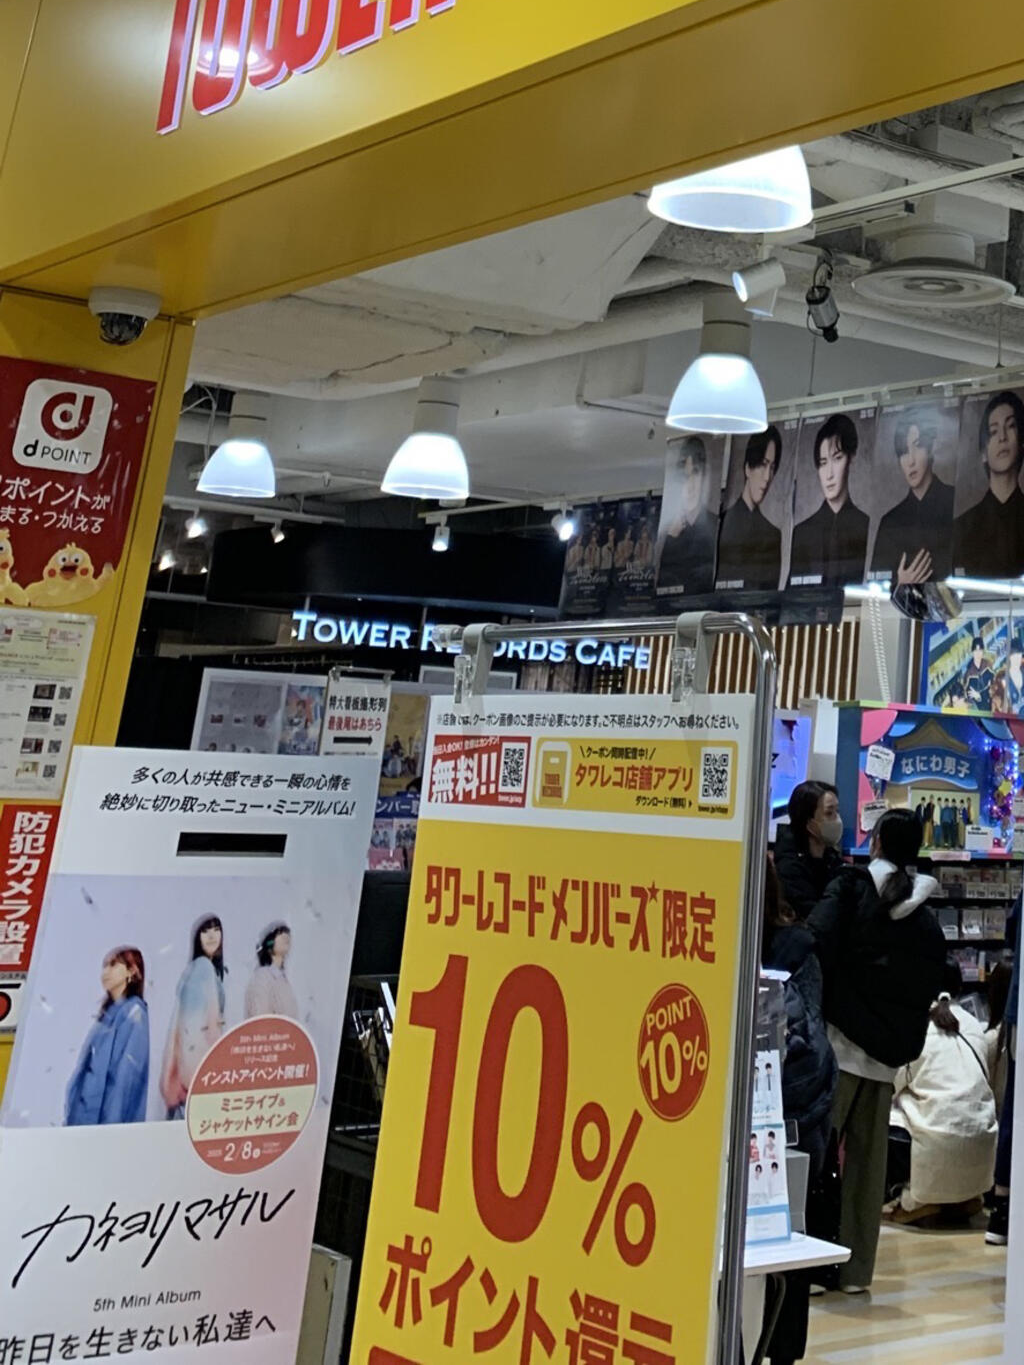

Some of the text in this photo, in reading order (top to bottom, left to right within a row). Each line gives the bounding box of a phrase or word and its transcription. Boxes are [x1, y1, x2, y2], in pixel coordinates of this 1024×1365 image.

[23, 439, 91, 464] d POINT
[292, 611, 411, 650] TOWER
[420, 623, 566, 664] RRDS
[131, 767, 352, 792] 多くの人が共感できる一瞬の心情を
[431, 751, 498, 803] 無料!!
[575, 763, 693, 793] タワレコ店舗アプリ
[901, 755, 970, 778] なにわ男子
[100, 793, 356, 817] 絶妙に切り取ったニュー・ミニアルバム!
[0, 811, 52, 965] 防犯カメラ設置
[646, 996, 693, 1035] POINT
[640, 1031, 708, 1102] 10%
[200, 1111, 299, 1134] ジャケットサイン会
[408, 953, 656, 1267] 10%
[11, 1187, 296, 1288] カネヨリマサル
[93, 1289, 201, 1312] 5th Mini Album
[379, 1234, 676, 1365] ポイント還元
[0, 1309, 277, 1365] 昨日を生きない私達へ
